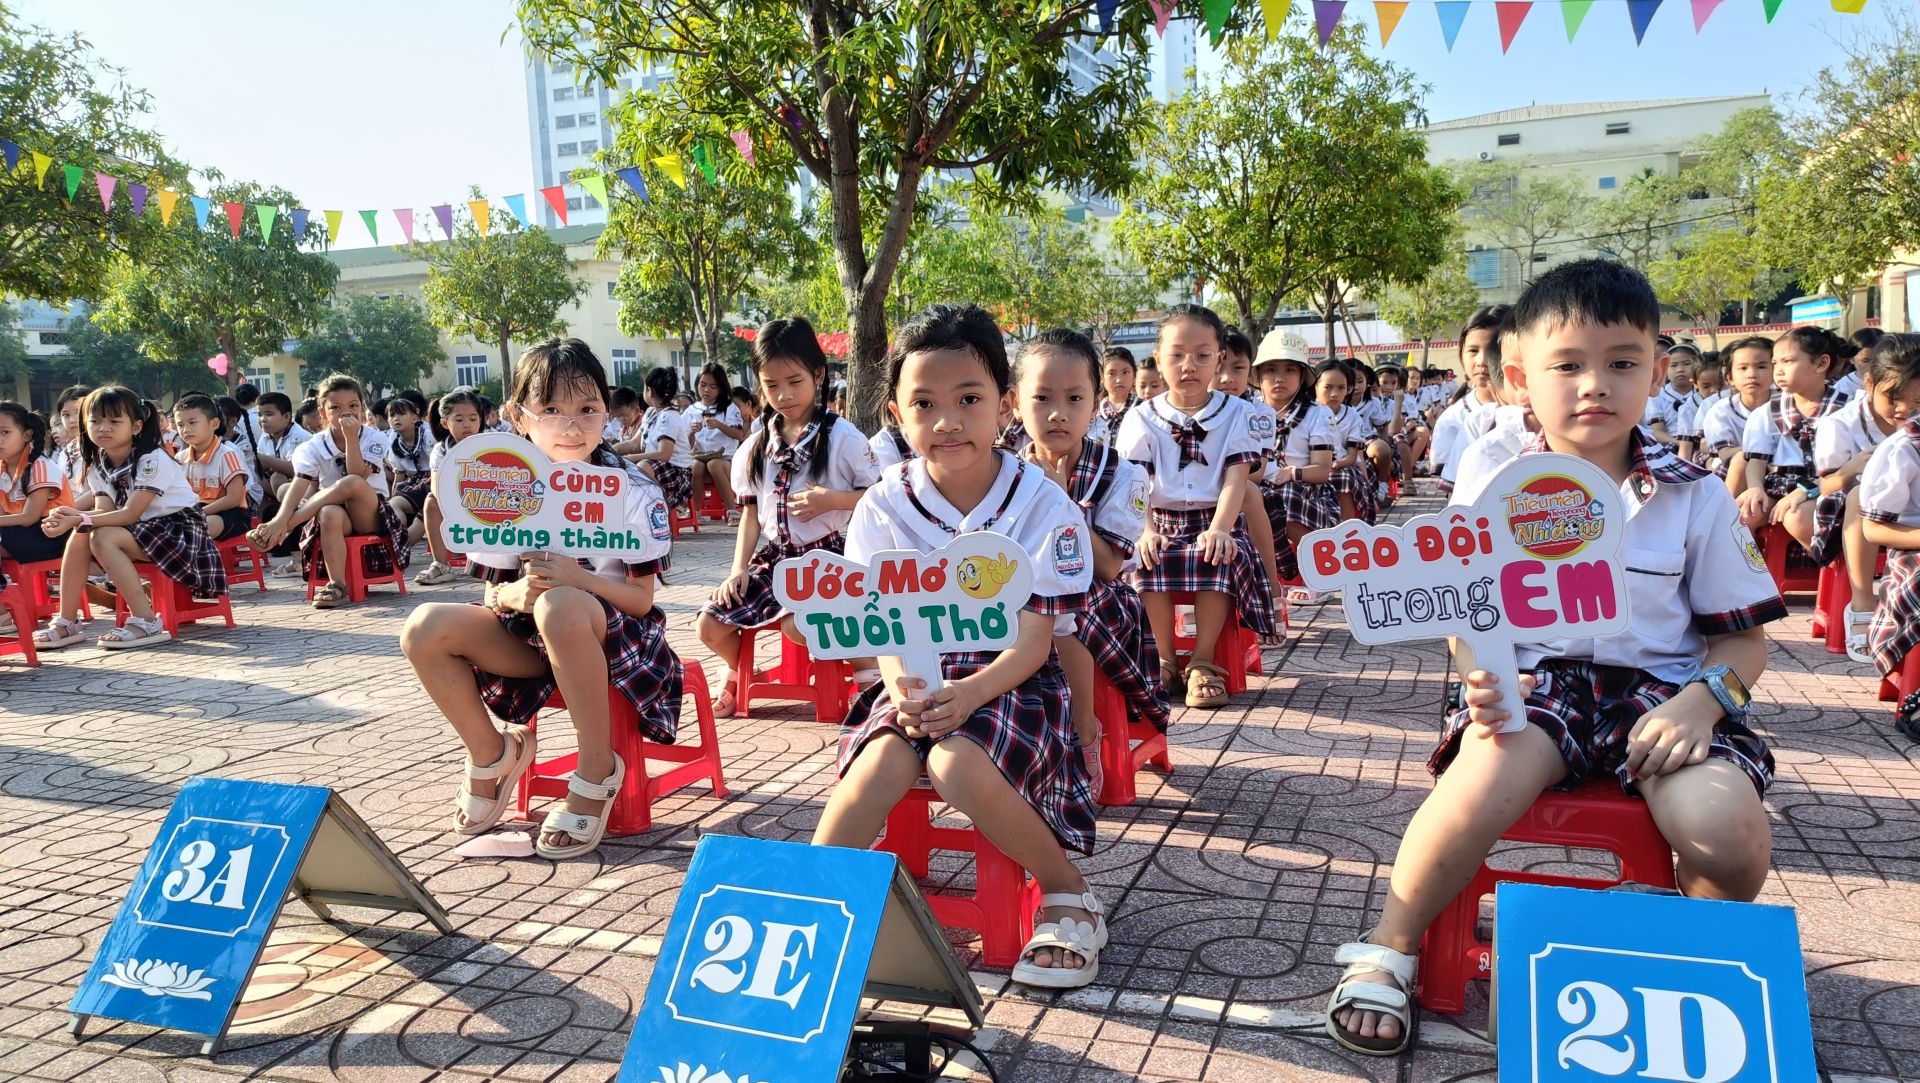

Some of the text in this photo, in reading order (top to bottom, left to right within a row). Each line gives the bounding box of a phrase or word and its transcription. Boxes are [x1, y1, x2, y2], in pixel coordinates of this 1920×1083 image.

[1281, 335, 1308, 355] GUCC
[448, 520, 641, 550] trưởng thành
[563, 501, 605, 524] em
[1312, 513, 1494, 577] Báo Đội
[785, 557, 949, 601] Ước Mơ
[1357, 559, 1618, 633] trong Em
[806, 591, 1009, 650] Tuổi Thơ
[161, 839, 254, 910] 3A
[689, 914, 818, 1010] 2E
[1556, 980, 1748, 1083] 2D
